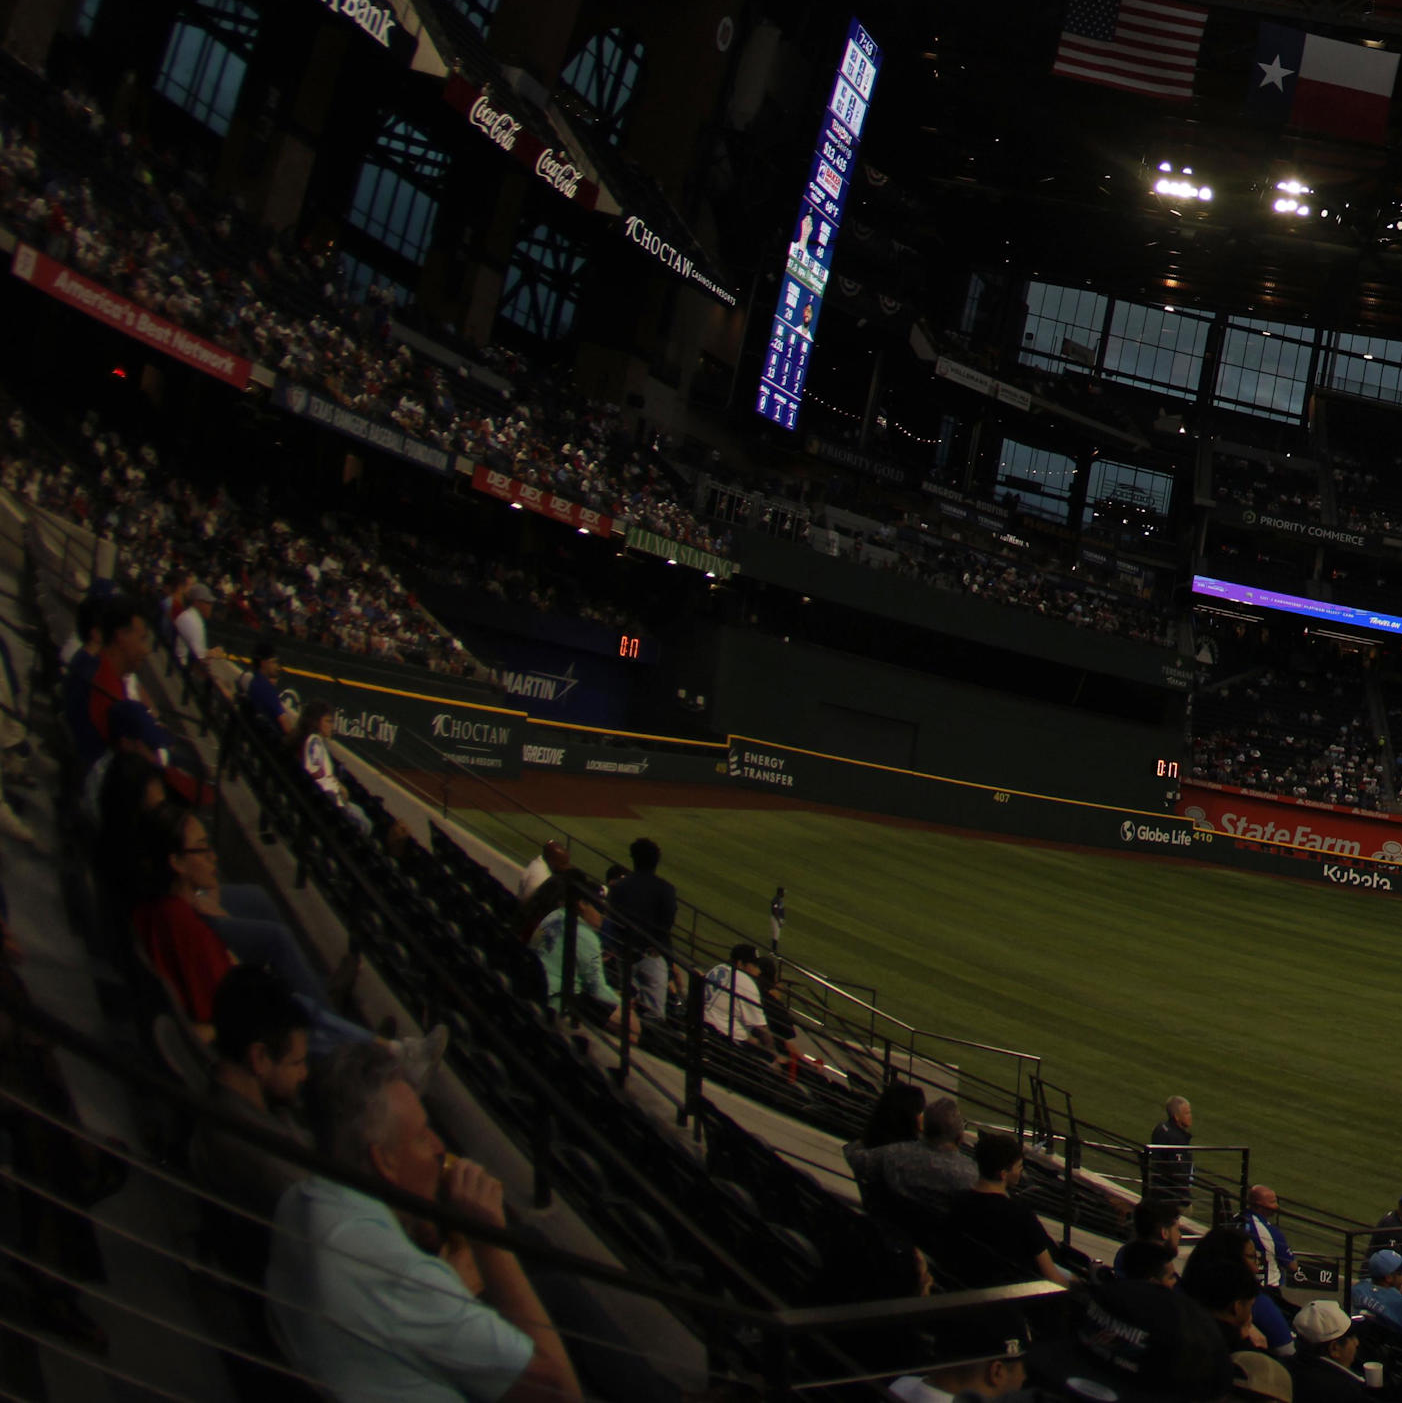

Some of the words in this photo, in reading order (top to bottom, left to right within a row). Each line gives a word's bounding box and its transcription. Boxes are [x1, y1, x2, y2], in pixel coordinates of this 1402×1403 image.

[469, 96, 523, 151] Coca-Cola
[535, 148, 585, 199] Coca-Cola
[631, 217, 694, 278] CHOCTAW
[54, 270, 135, 327] America's
[134, 313, 172, 345] Best
[171, 329, 236, 376] Network
[486, 469, 512, 491] DEX
[519, 483, 545, 503] DEX
[550, 495, 572, 514] DEX
[578, 506, 601, 526] DEX
[1260, 515, 1307, 537] PRIORITY
[1308, 525, 1366, 547] COMMERCE
[501, 670, 557, 700] MARTIN
[366, 714, 399, 749] City
[436, 714, 511, 745] CHOCTAW
[744, 751, 785, 770] ENERGY
[1157, 759, 1179, 779] 0:17
[743, 766, 794, 788] TRANSFER
[1137, 825, 1170, 844] Globe
[1171, 830, 1192, 847] Life
[1192, 830, 1214, 843] 410
[1324, 863, 1393, 892] Kubota
[1320, 1269, 1334, 1285] 02
